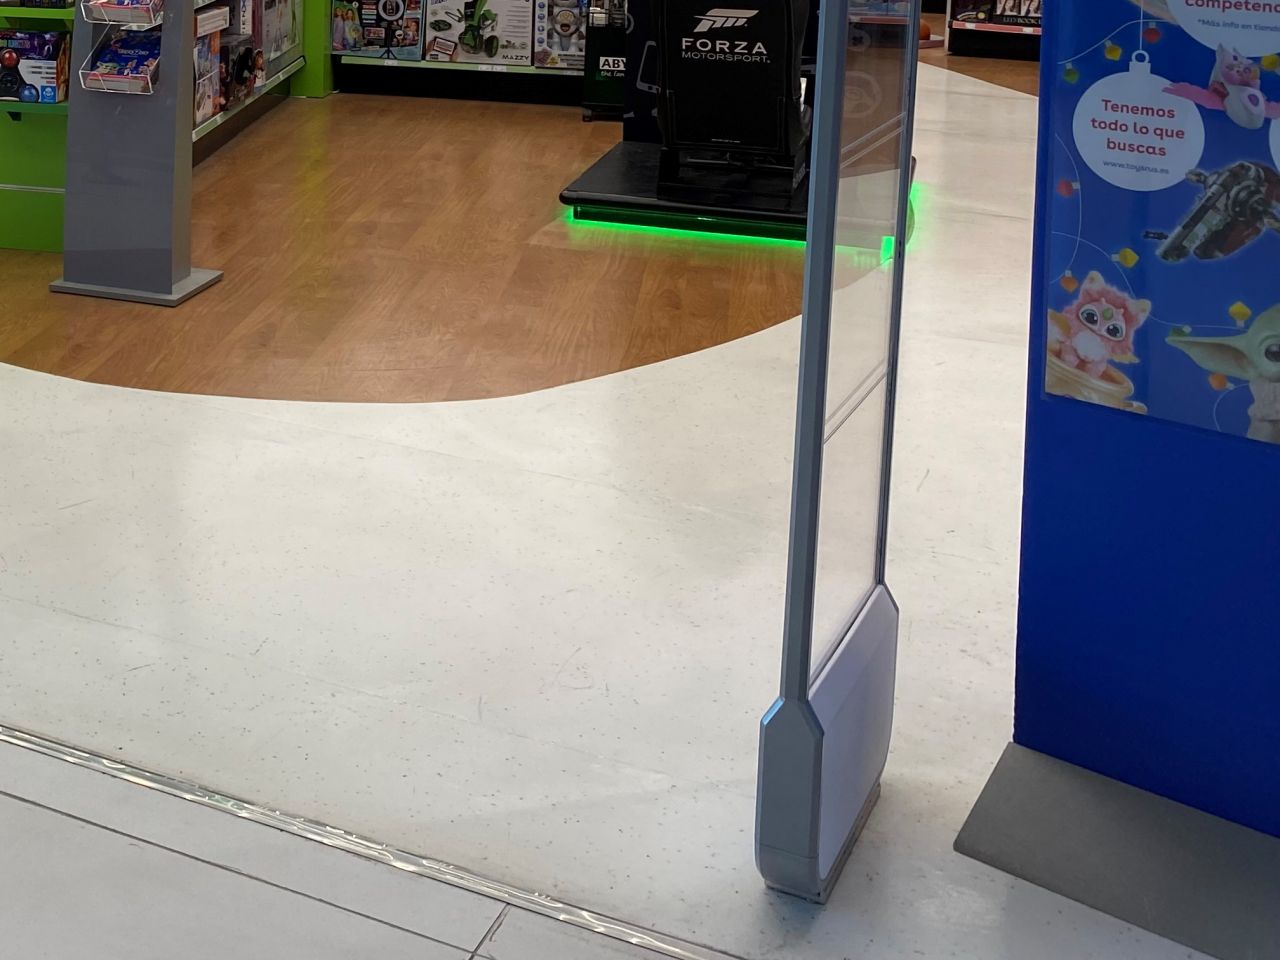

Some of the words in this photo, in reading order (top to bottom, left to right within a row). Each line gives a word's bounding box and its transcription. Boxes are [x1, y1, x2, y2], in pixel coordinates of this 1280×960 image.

[1222, 20, 1240, 29] info
[1241, 22, 1253, 30] en
[681, 37, 768, 55] FORZA
[681, 51, 769, 63] MOTORSPORT
[1101, 98, 1176, 119] Tenemos
[1090, 117, 1129, 133] todo
[1133, 122, 1149, 135] lo
[1153, 126, 1185, 141] que
[1106, 137, 1167, 157] buscas
